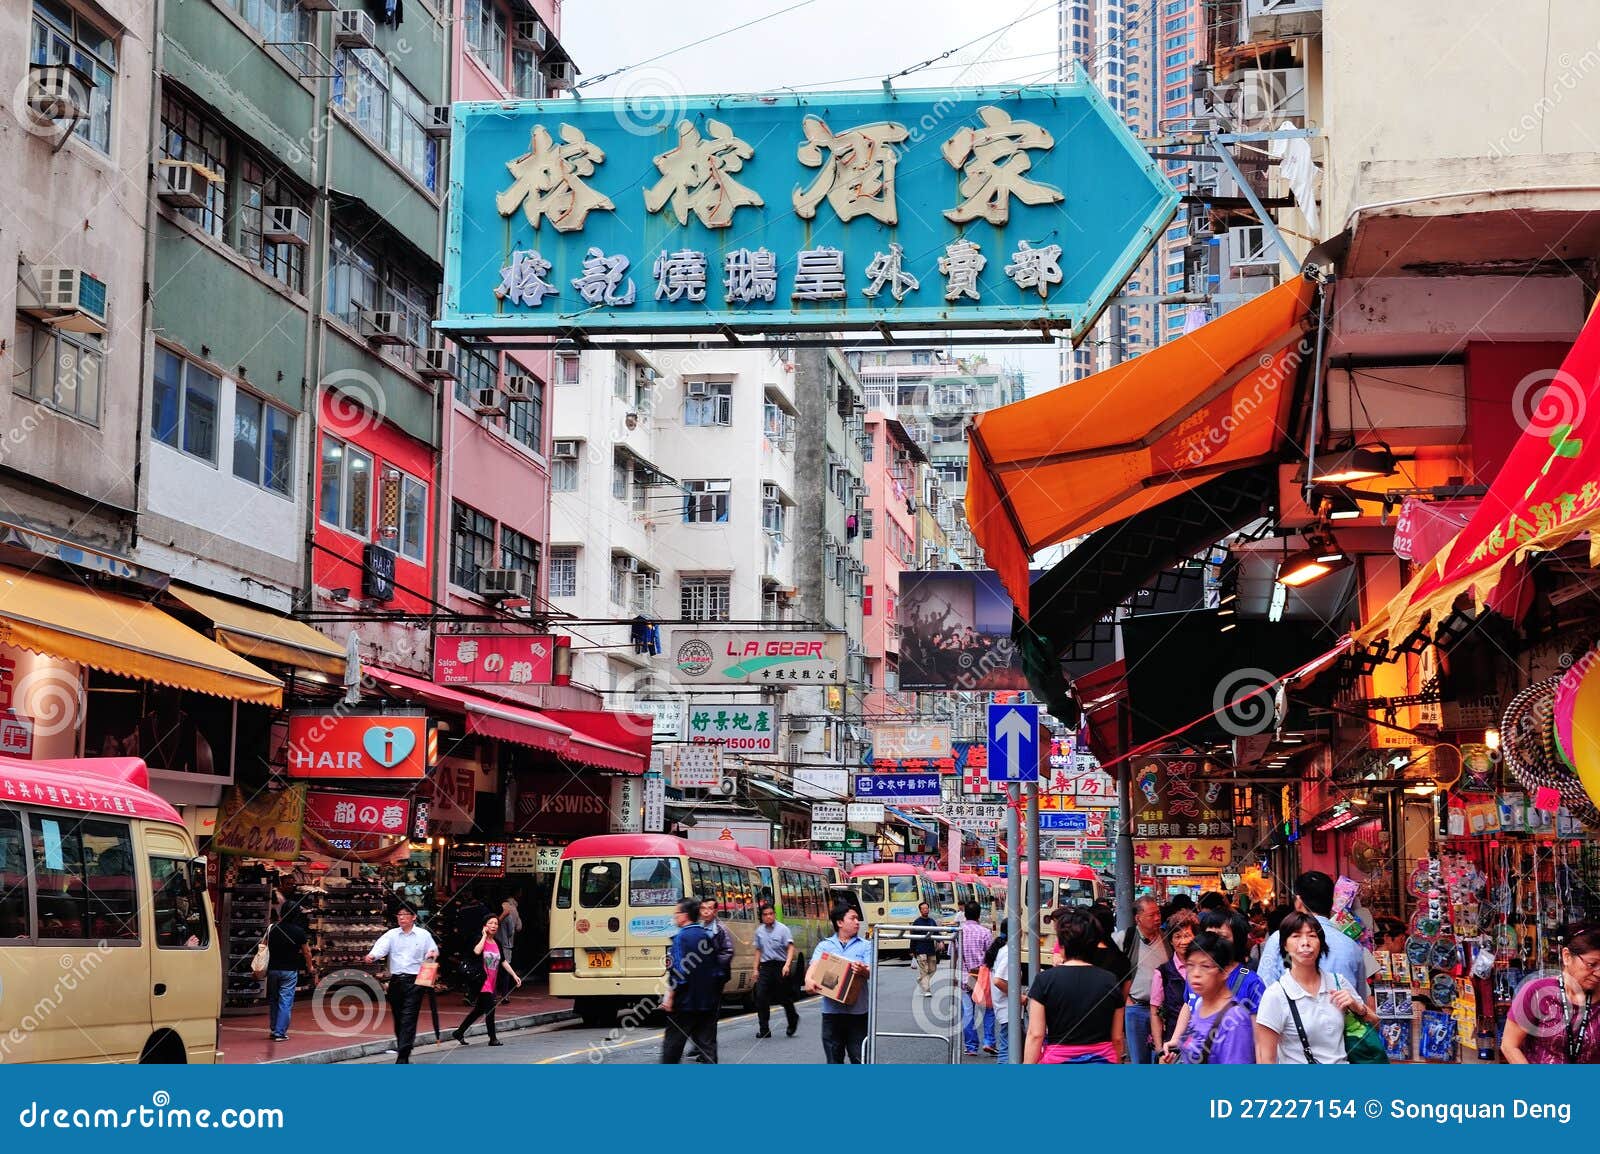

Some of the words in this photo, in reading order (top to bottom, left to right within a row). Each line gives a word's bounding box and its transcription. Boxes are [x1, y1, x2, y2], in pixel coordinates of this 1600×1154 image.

[496, 106, 1065, 233] 榕榕酒家
[493, 239, 1064, 307] 榕記燒鵝皇外賣部
[438, 659, 457, 667] Salon
[691, 711, 770, 732] 好景地產
[296, 751, 363, 769] HAIR
[590, 959, 612, 967] 4910
